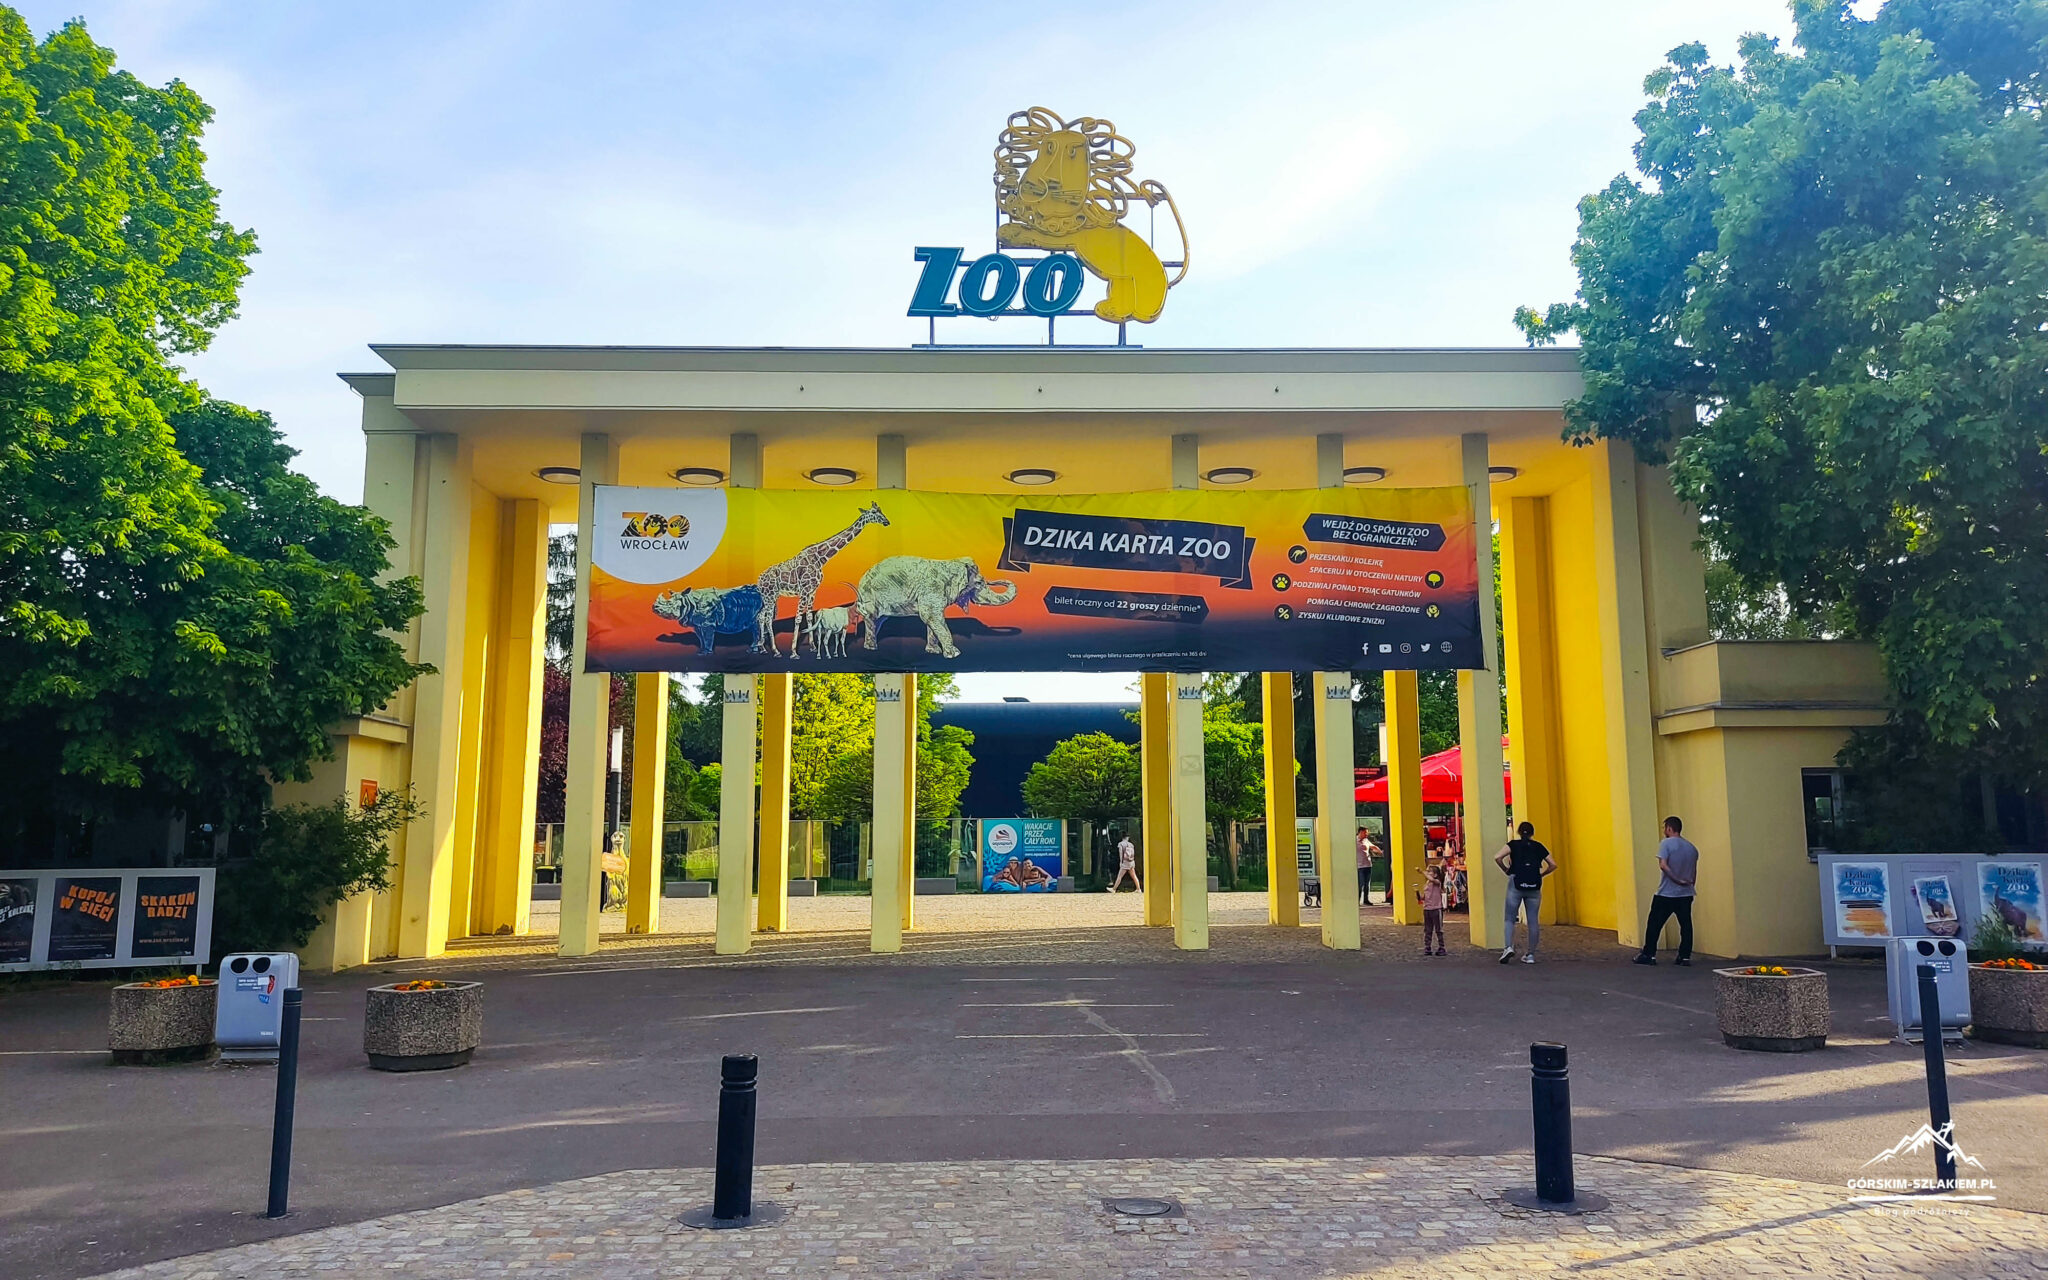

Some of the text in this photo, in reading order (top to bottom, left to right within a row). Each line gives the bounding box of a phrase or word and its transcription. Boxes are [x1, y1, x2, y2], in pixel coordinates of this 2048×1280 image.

[907, 246, 1084, 317] ZOO
[621, 512, 690, 538] ZOO
[1322, 519, 1430, 537] WEJDŹ DO SPÓŁKI ZOO
[620, 540, 690, 550] WROCŁAW
[1023, 526, 1231, 560] DZIKA KARTA ZOO
[1332, 530, 1418, 546] BEZ OGRANICZEŃ:
[1309, 553, 1384, 568] PRZESKAKUJ KOLEJKĘ
[1309, 566, 1345, 575] SPACERUJ
[1353, 570, 1394, 580] OTOCZENIU
[1394, 574, 1423, 582] NATURY
[1292, 581, 1421, 598] PODZIWIAJ PONAD TYSIĄC GATUNKÓW
[1054, 595, 1073, 605] bilet
[1074, 599, 1102, 609] roczny
[1103, 600, 1115, 608] od
[1116, 600, 1128, 609] 22
[1129, 602, 1160, 612] groszy
[1306, 597, 1421, 614] POMAGAJ CHRONIĆ ZAGROŻONE
[1298, 611, 1326, 620] ZYSKUJ
[1326, 613, 1361, 623] KLUBOWE
[1024, 822, 1054, 830] WAKACJE
[1024, 830, 1045, 838] PRZEZ
[68, 885, 117, 905] KUPUJ
[1852, 886, 1872, 894] ZOO
[2007, 883, 2030, 891] ZOO
[141, 891, 196, 907] SKAKUN
[60, 896, 115, 922] W SIECI
[147, 906, 188, 919] RADZI
